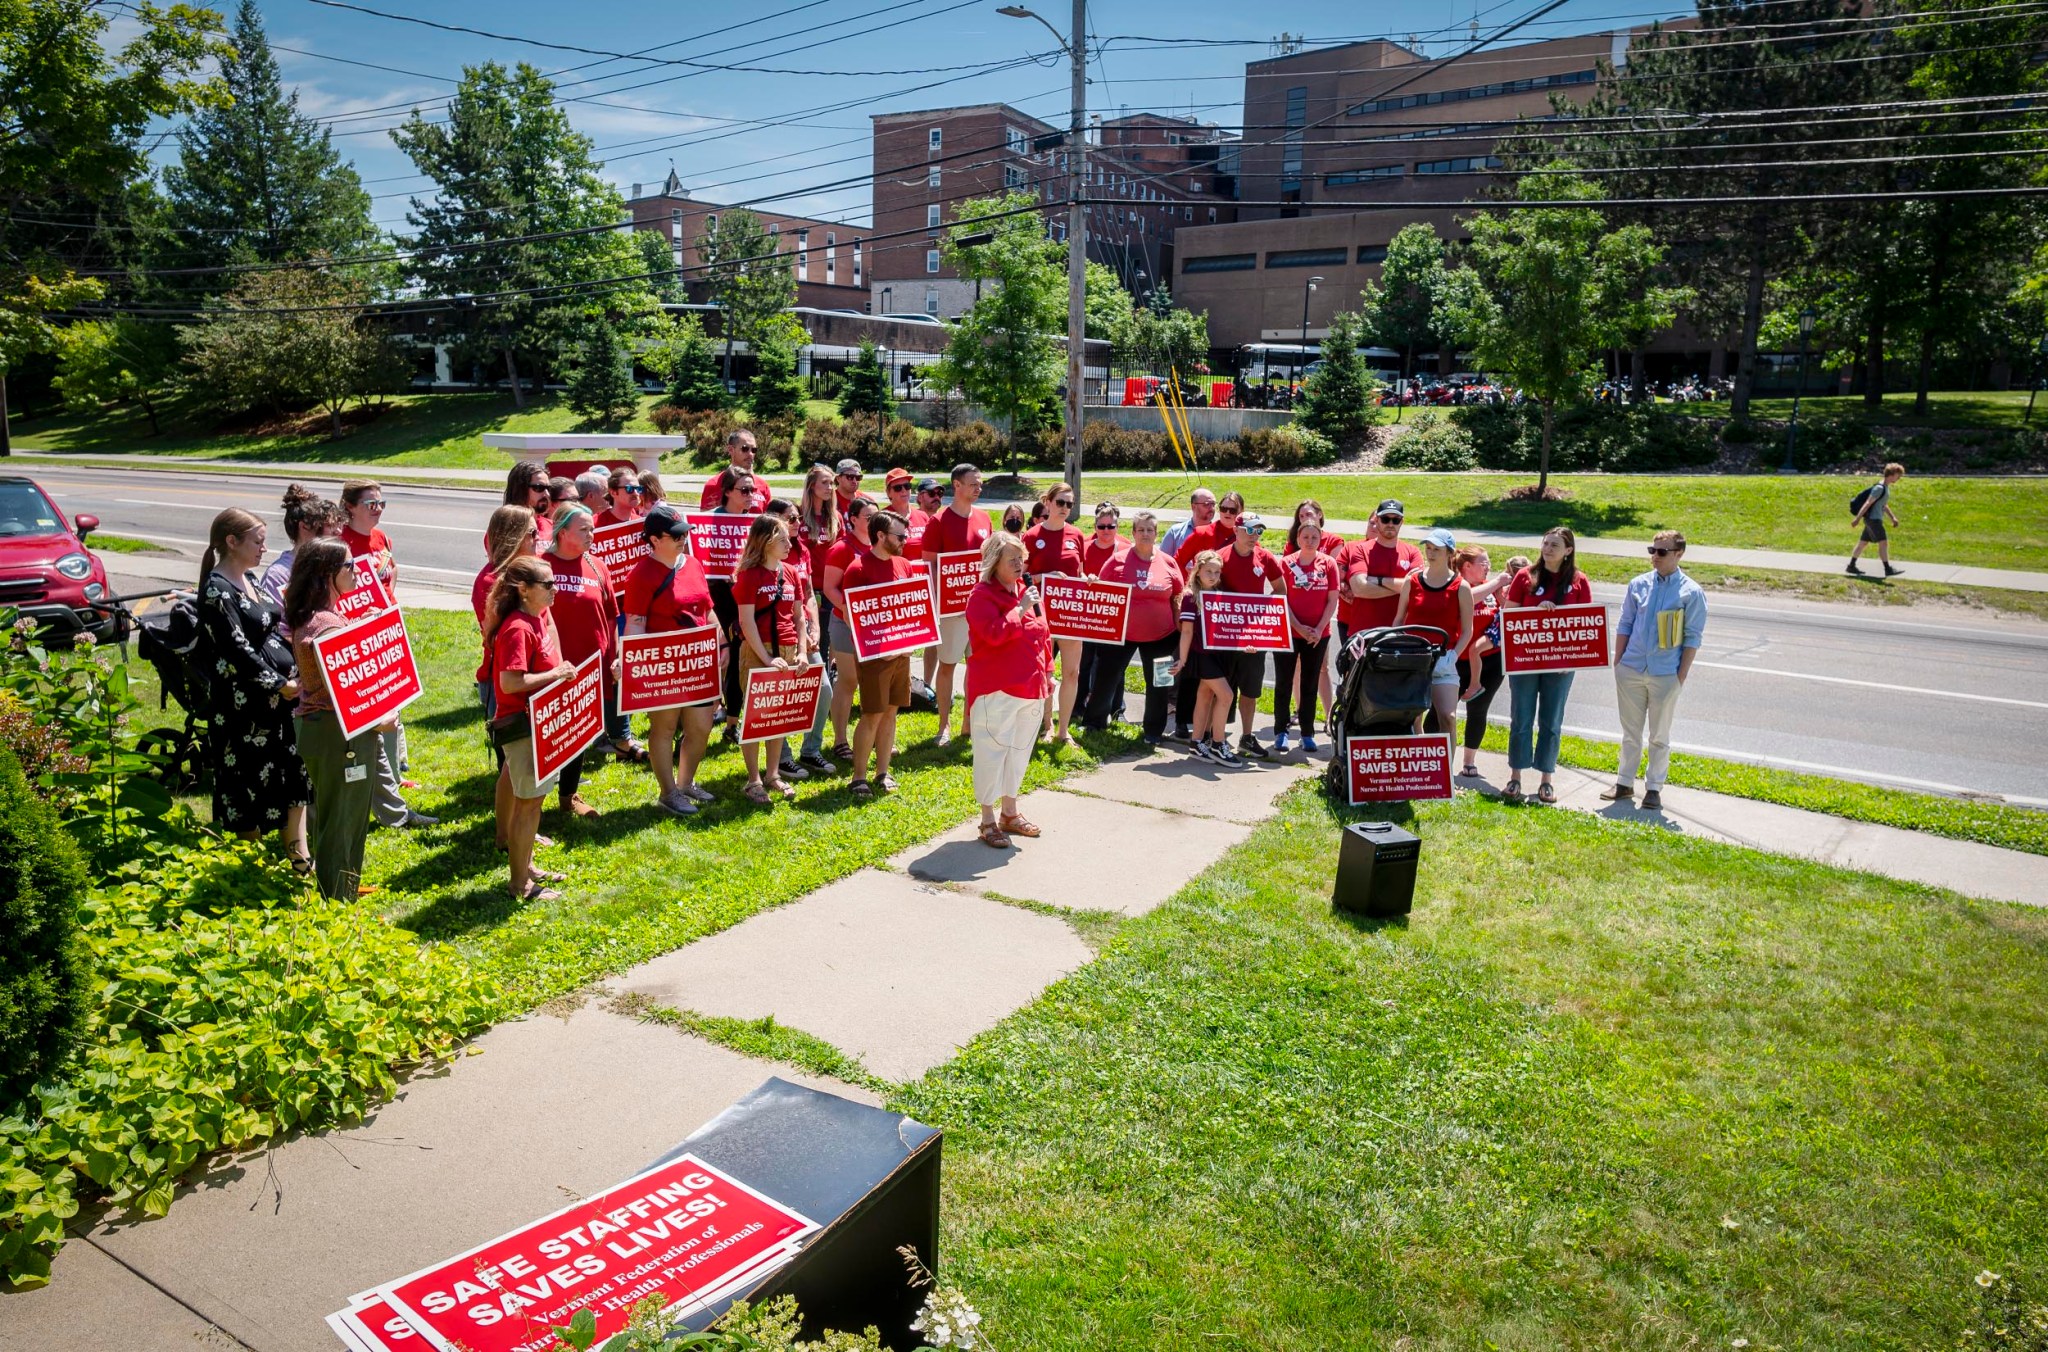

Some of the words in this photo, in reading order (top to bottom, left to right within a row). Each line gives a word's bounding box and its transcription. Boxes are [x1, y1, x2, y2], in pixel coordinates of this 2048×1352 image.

[590, 538, 615, 554] SAFE
[617, 532, 642, 548] STAFF
[698, 537, 732, 549] SAVES
[942, 563, 966, 575] SAFE
[570, 575, 599, 587] UNION
[946, 574, 976, 588] SAVES
[852, 598, 879, 613] SAFE
[881, 589, 928, 608] STAFFING
[1046, 586, 1073, 598] SAFE
[1076, 589, 1126, 604] STAFFING
[860, 610, 893, 627] SAVES
[895, 604, 927, 620] LIVES!
[1050, 599, 1083, 612] SAVES
[1086, 603, 1119, 616] LIVES!
[1205, 601, 1231, 612] SAFE
[1234, 603, 1284, 614] STAFFING
[1080, 616, 1102, 624] Federation
[1088, 624, 1116, 633] Professionals
[1211, 613, 1244, 624] SAVES
[1247, 615, 1281, 626] LIVES!
[1506, 619, 1538, 631] SAFE
[1542, 615, 1604, 629] STAFFING
[865, 638, 881, 646] Nurses
[887, 633, 902, 641] Health
[902, 628, 931, 639] Professionals
[872, 628, 891, 636] Vermont
[891, 623, 915, 632] Federation
[1513, 632, 1554, 644] SAVES
[1558, 629, 1598, 642] LIVES!
[326, 645, 360, 671] SAFE
[360, 622, 404, 656] STAFFING
[625, 648, 659, 663] SAFE
[664, 638, 716, 659] STAFFING
[1562, 652, 1599, 660] Professionals
[338, 658, 377, 689] SAVES
[377, 643, 405, 671] LIVES!
[631, 661, 675, 678] SAVES
[679, 654, 713, 673] LIVES!
[356, 681, 378, 699] Vermont
[378, 672, 397, 689] Federation
[632, 691, 652, 700] Nurses
[661, 686, 680, 696] Health
[682, 681, 714, 693] Professionals
[643, 680, 669, 688] Vermont
[670, 675, 700, 686] Federation
[751, 681, 776, 694] SAFE
[778, 676, 819, 692] STAFFING
[349, 702, 370, 716] Nurses
[376, 688, 389, 702] Health
[389, 675, 412, 696] Professionals
[536, 697, 560, 724] SAFE
[562, 668, 600, 707] STAFFING
[753, 695, 784, 709] SAVES
[786, 691, 813, 705] LIVES!
[542, 708, 572, 740] SAVES
[573, 687, 597, 717] LIVES!
[779, 708, 798, 717] Federation
[785, 715, 808, 723] Professionals
[544, 749, 559, 763] Nurses
[564, 735, 577, 749] Health
[577, 716, 598, 740] Professionals
[552, 729, 569, 747] Vermont
[569, 716, 587, 735] Federation
[1352, 748, 1381, 760] SAFE
[1385, 746, 1446, 759] STAFFING
[1359, 762, 1397, 774] SAVES
[1401, 760, 1441, 772] LIVES!
[420, 1254, 538, 1314] SAFE
[538, 1172, 715, 1260] STAFFING
[467, 1253, 606, 1326] SAVES
[607, 1192, 728, 1260] LIVES!
[601, 1277, 666, 1312] Health
[662, 1222, 764, 1280] Professionals
[530, 1282, 614, 1324] Vermont
[611, 1238, 702, 1286] Federation
[702, 1224, 720, 1239] of
